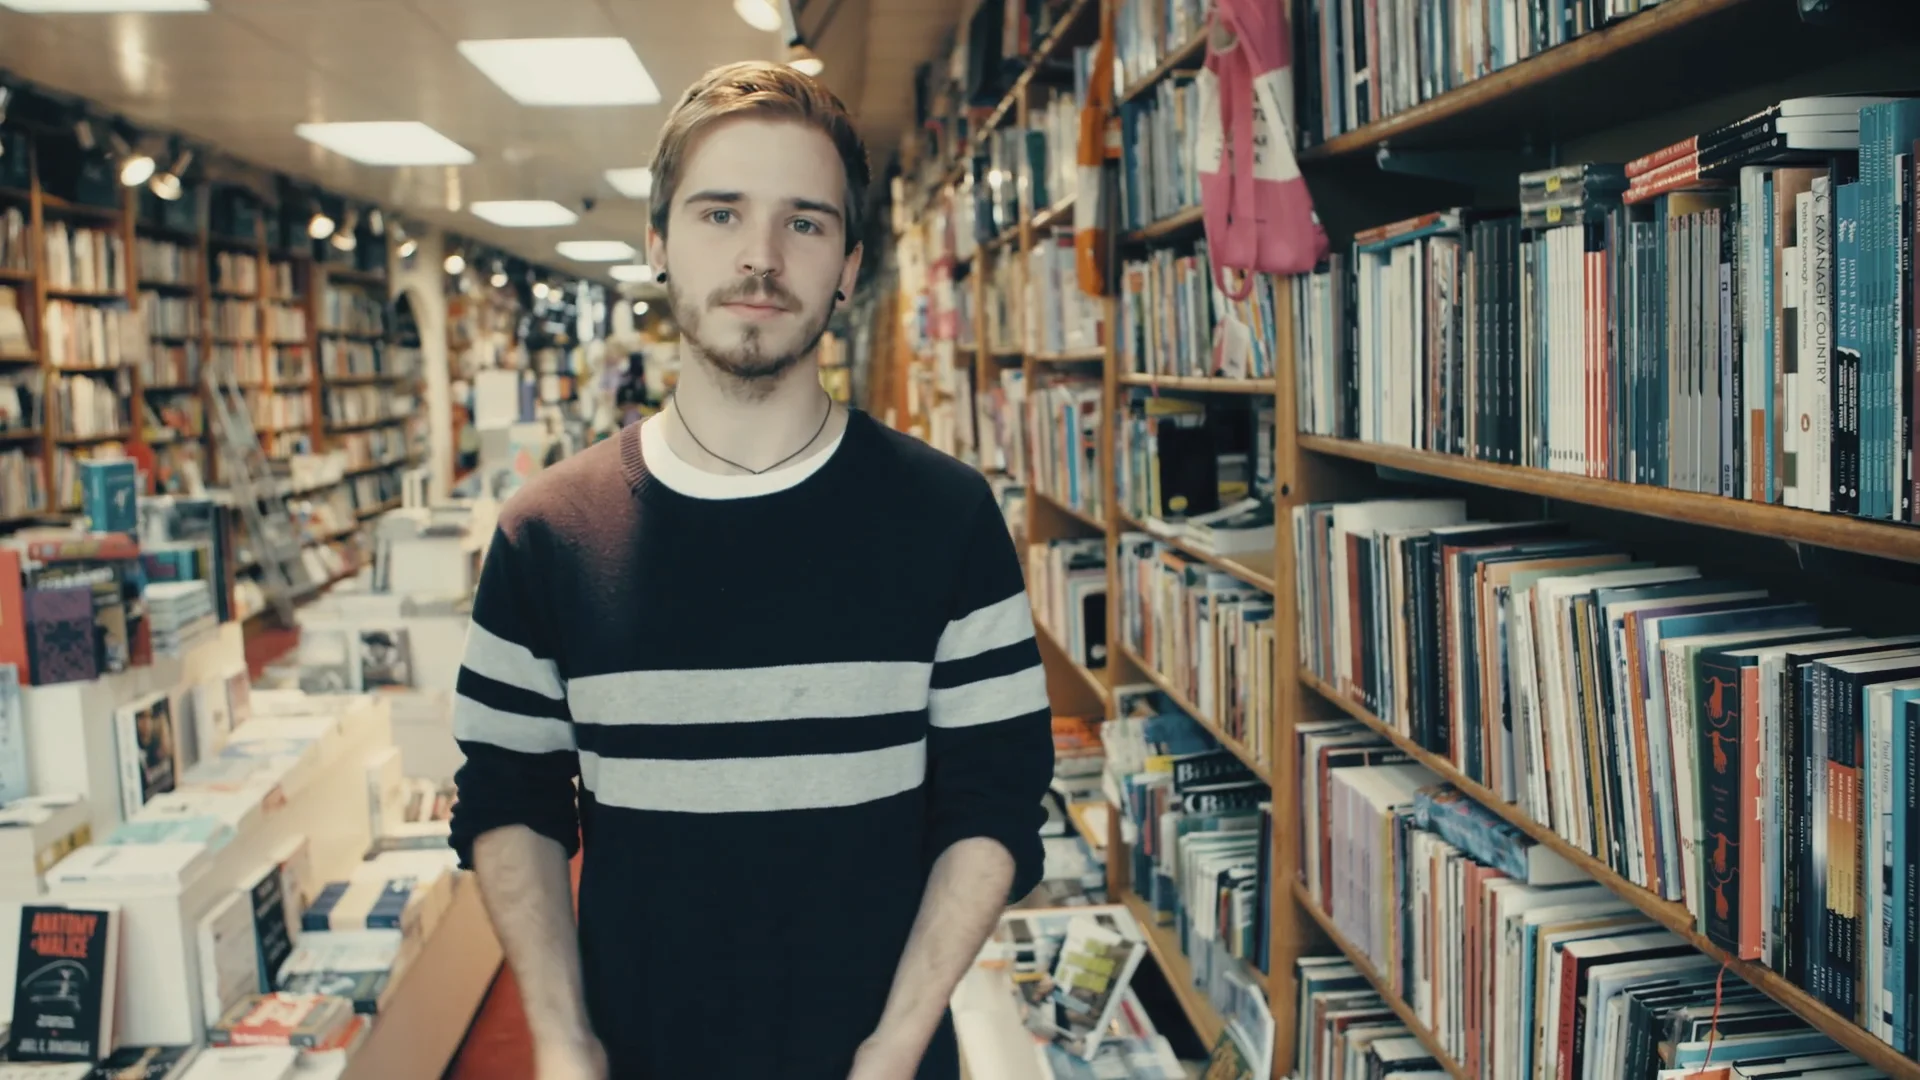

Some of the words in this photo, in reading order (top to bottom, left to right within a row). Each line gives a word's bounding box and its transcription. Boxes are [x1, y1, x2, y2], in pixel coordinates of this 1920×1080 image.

[1816, 214, 1826, 306] KAVANAGH
[1816, 311, 1826, 385] COUNTRY
[1882, 741, 1891, 759] Paul
[1882, 762, 1891, 794] Murray
[36, 934, 88, 958] MALICE
[1883, 920, 1891, 945] Paper
